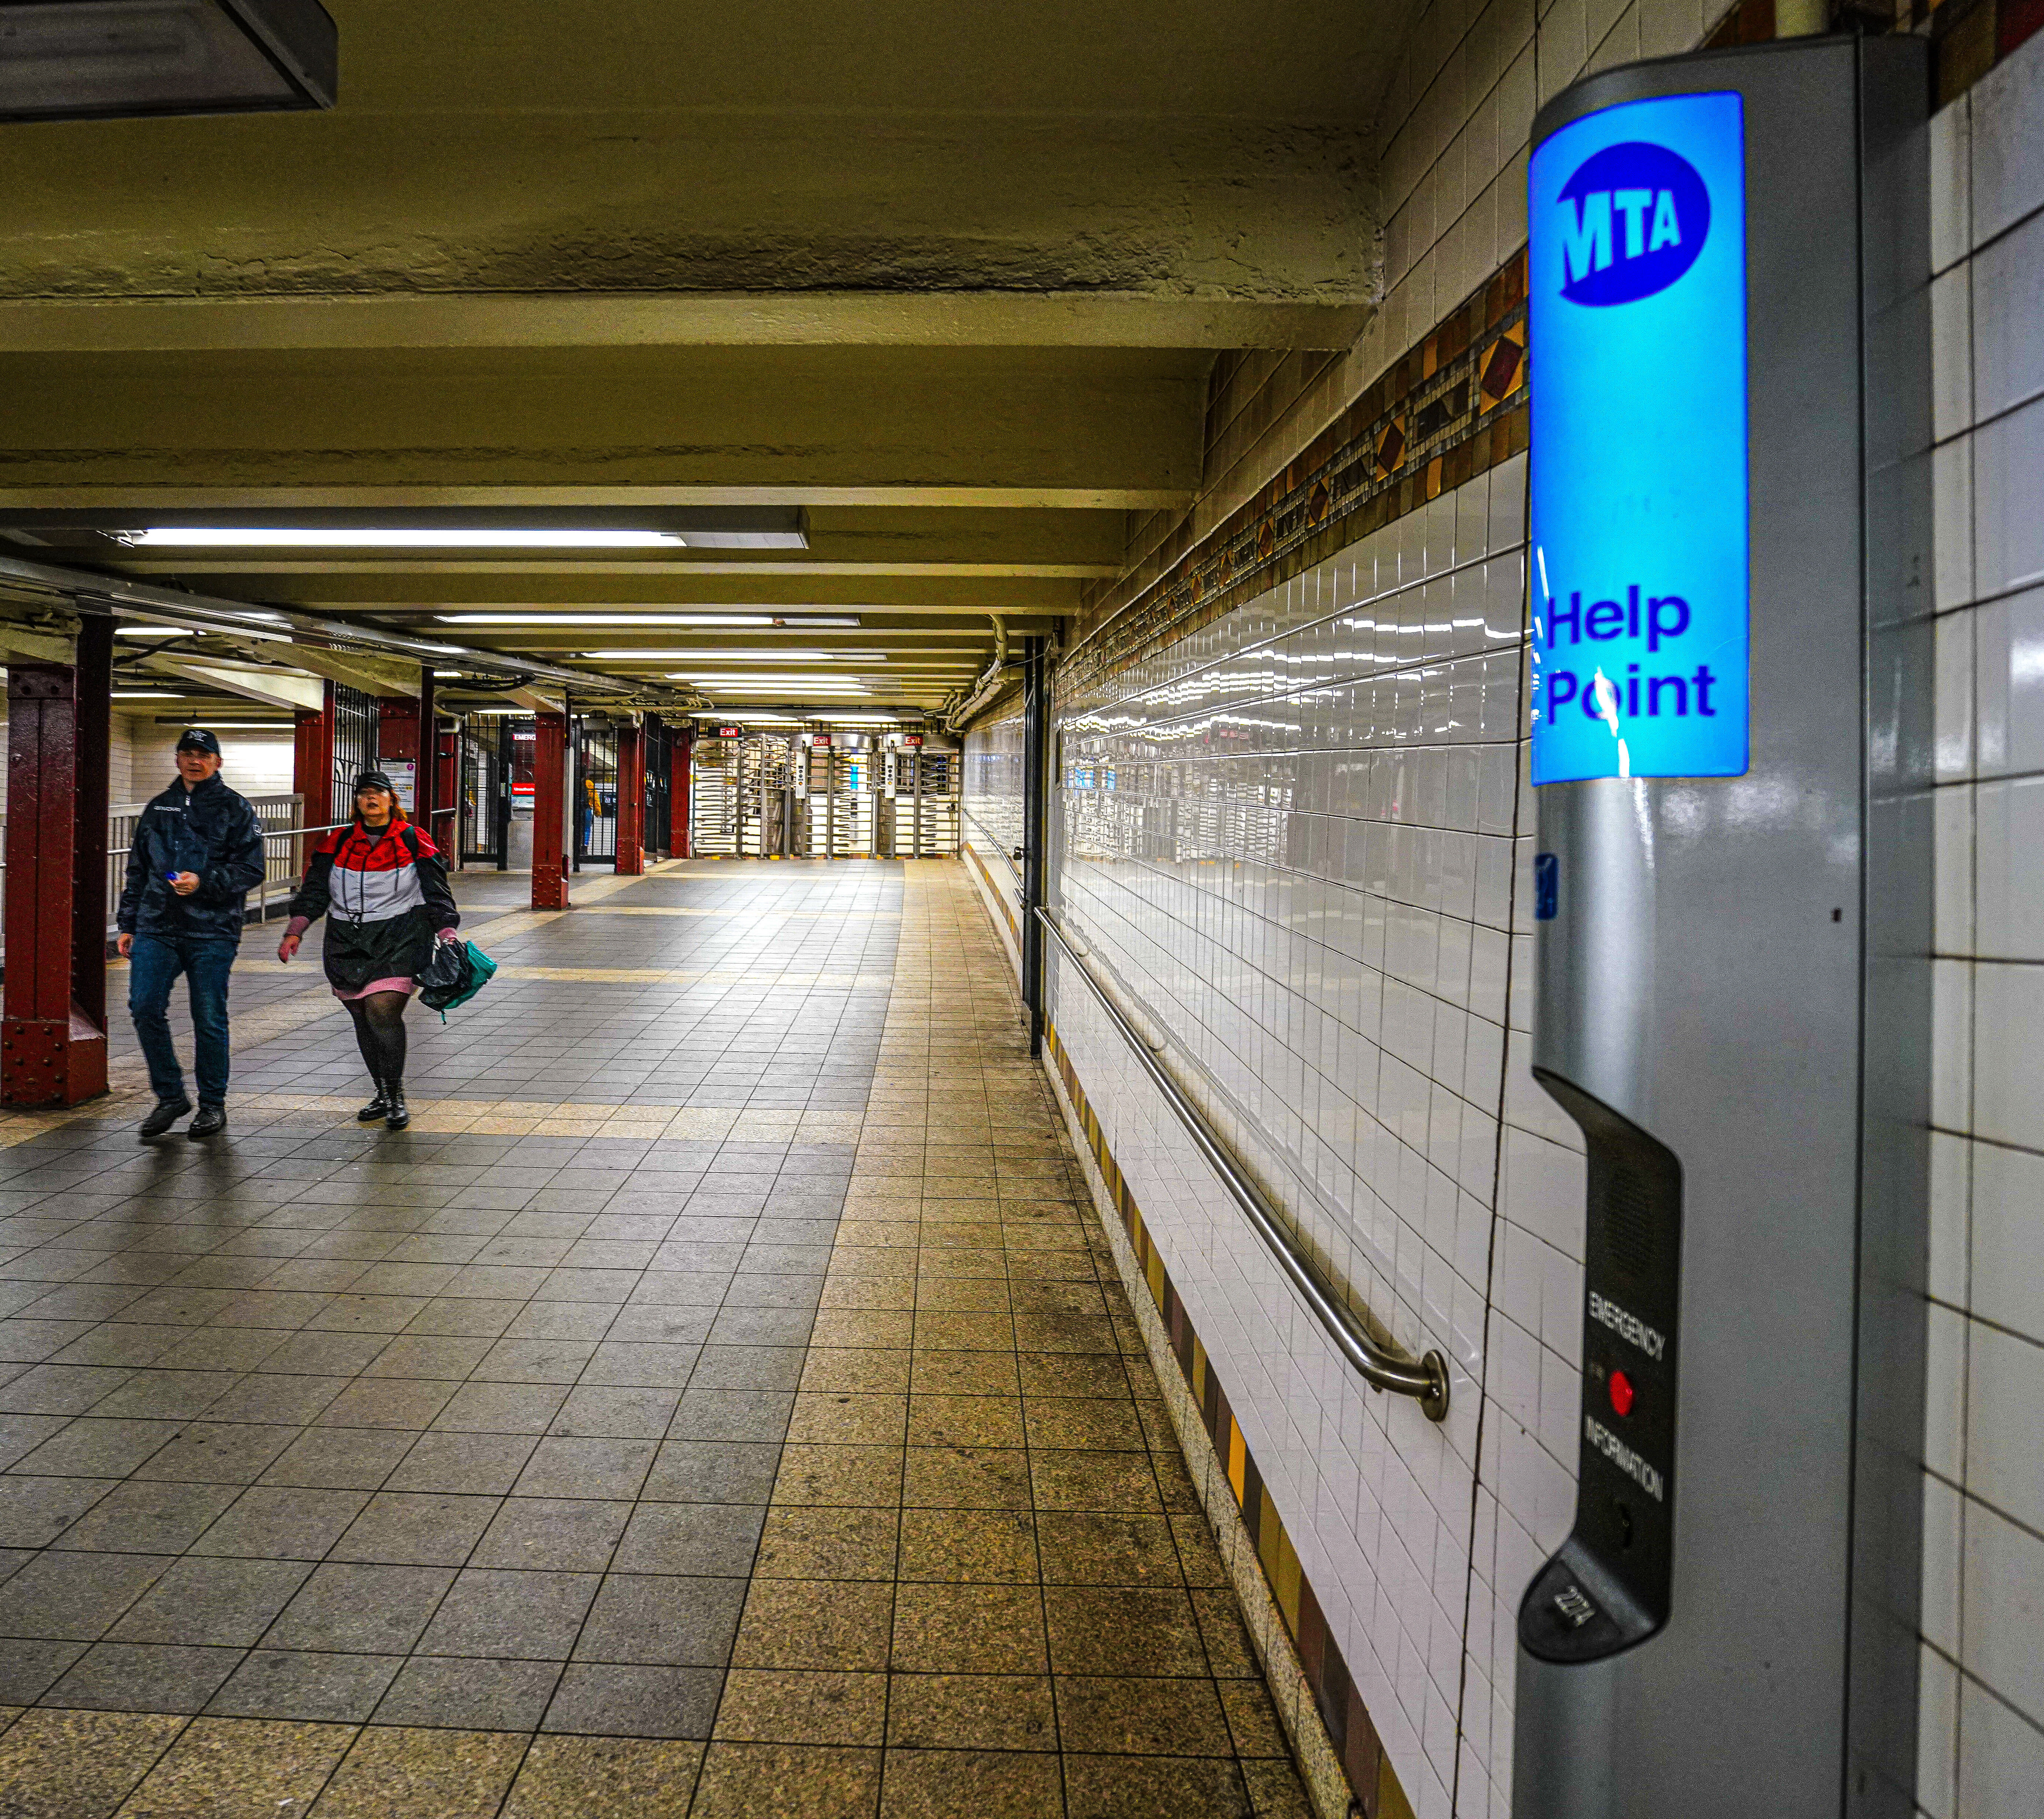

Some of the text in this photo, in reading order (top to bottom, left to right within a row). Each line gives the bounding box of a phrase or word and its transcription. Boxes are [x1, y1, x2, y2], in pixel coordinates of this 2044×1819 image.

[1557, 188, 1682, 285] MTA
[1547, 584, 1690, 652] Help
[1548, 664, 1717, 725] Point
[1589, 1291, 1666, 1362] EMERGENCY
[1585, 1415, 1663, 1502] INFORMATION
